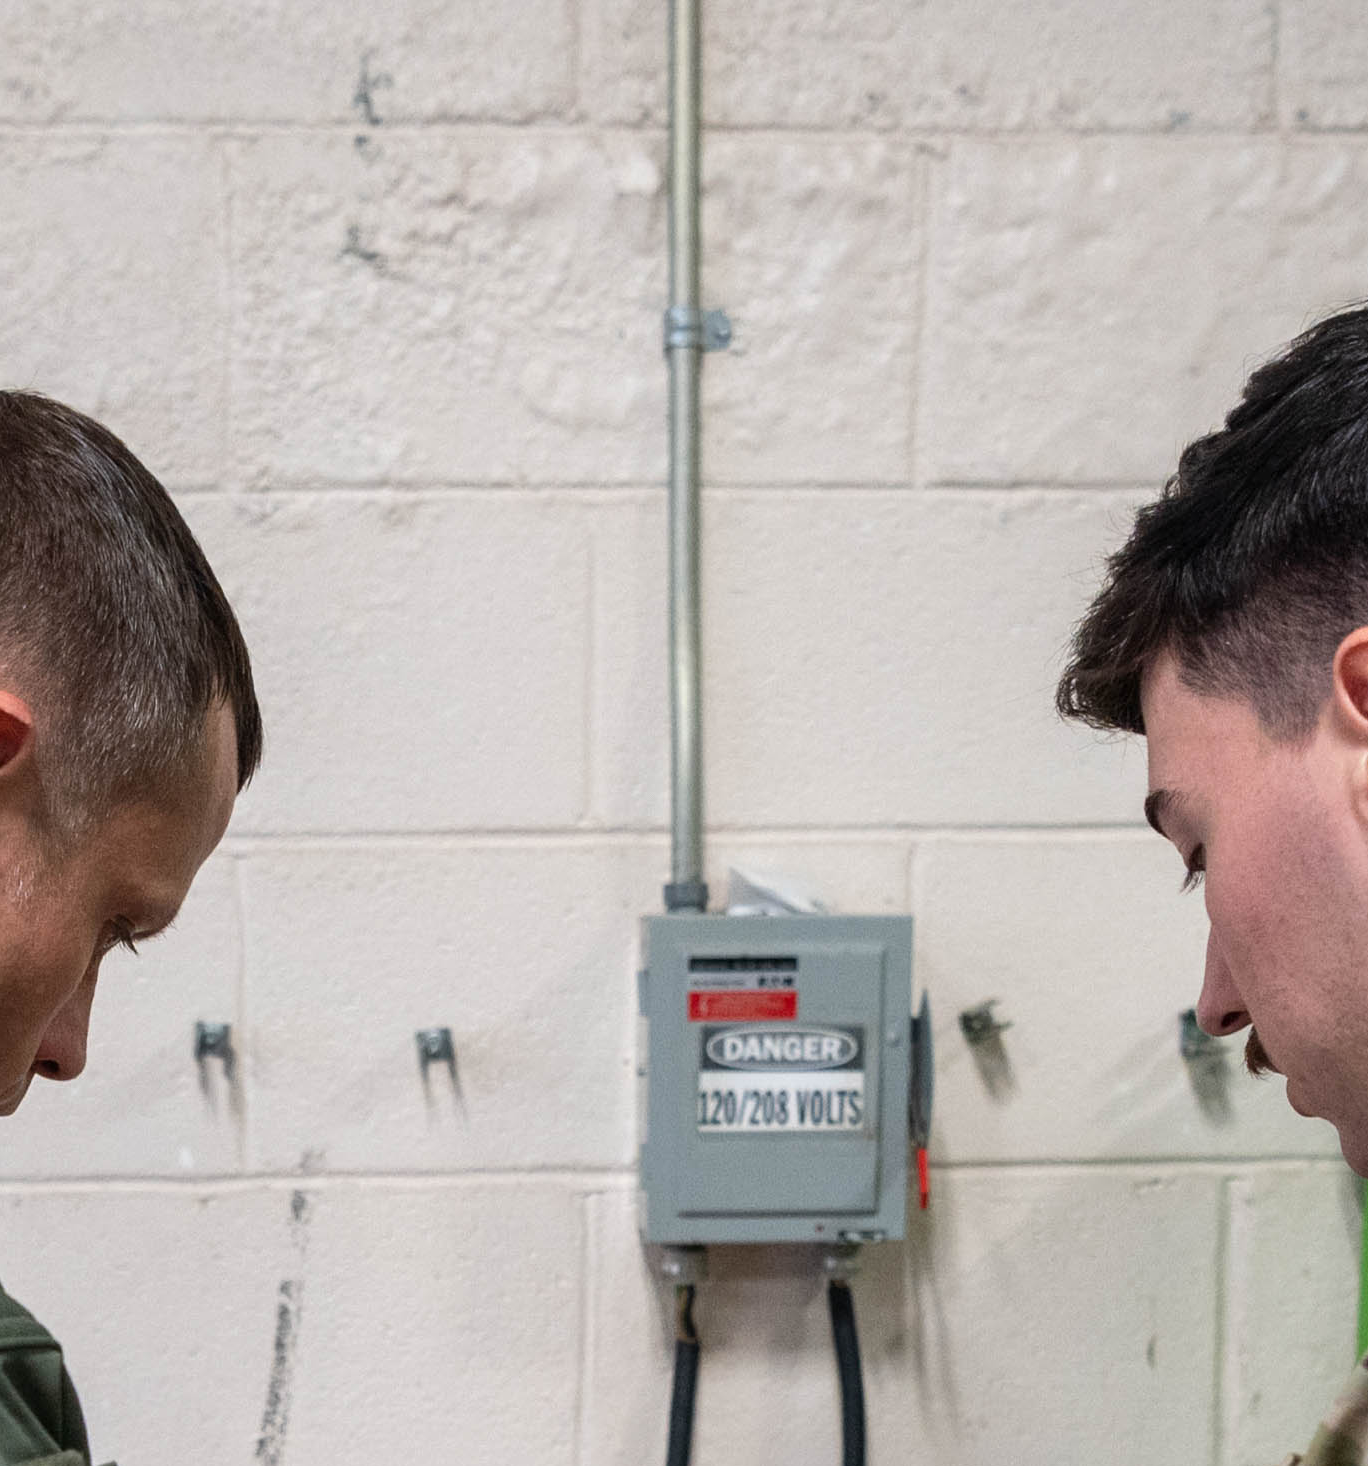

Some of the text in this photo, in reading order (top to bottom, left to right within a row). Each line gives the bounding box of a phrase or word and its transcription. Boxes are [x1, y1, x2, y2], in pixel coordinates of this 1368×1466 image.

[723, 1034, 844, 1061] DANGER
[699, 1090, 862, 1125] 120/208 VOLTS
